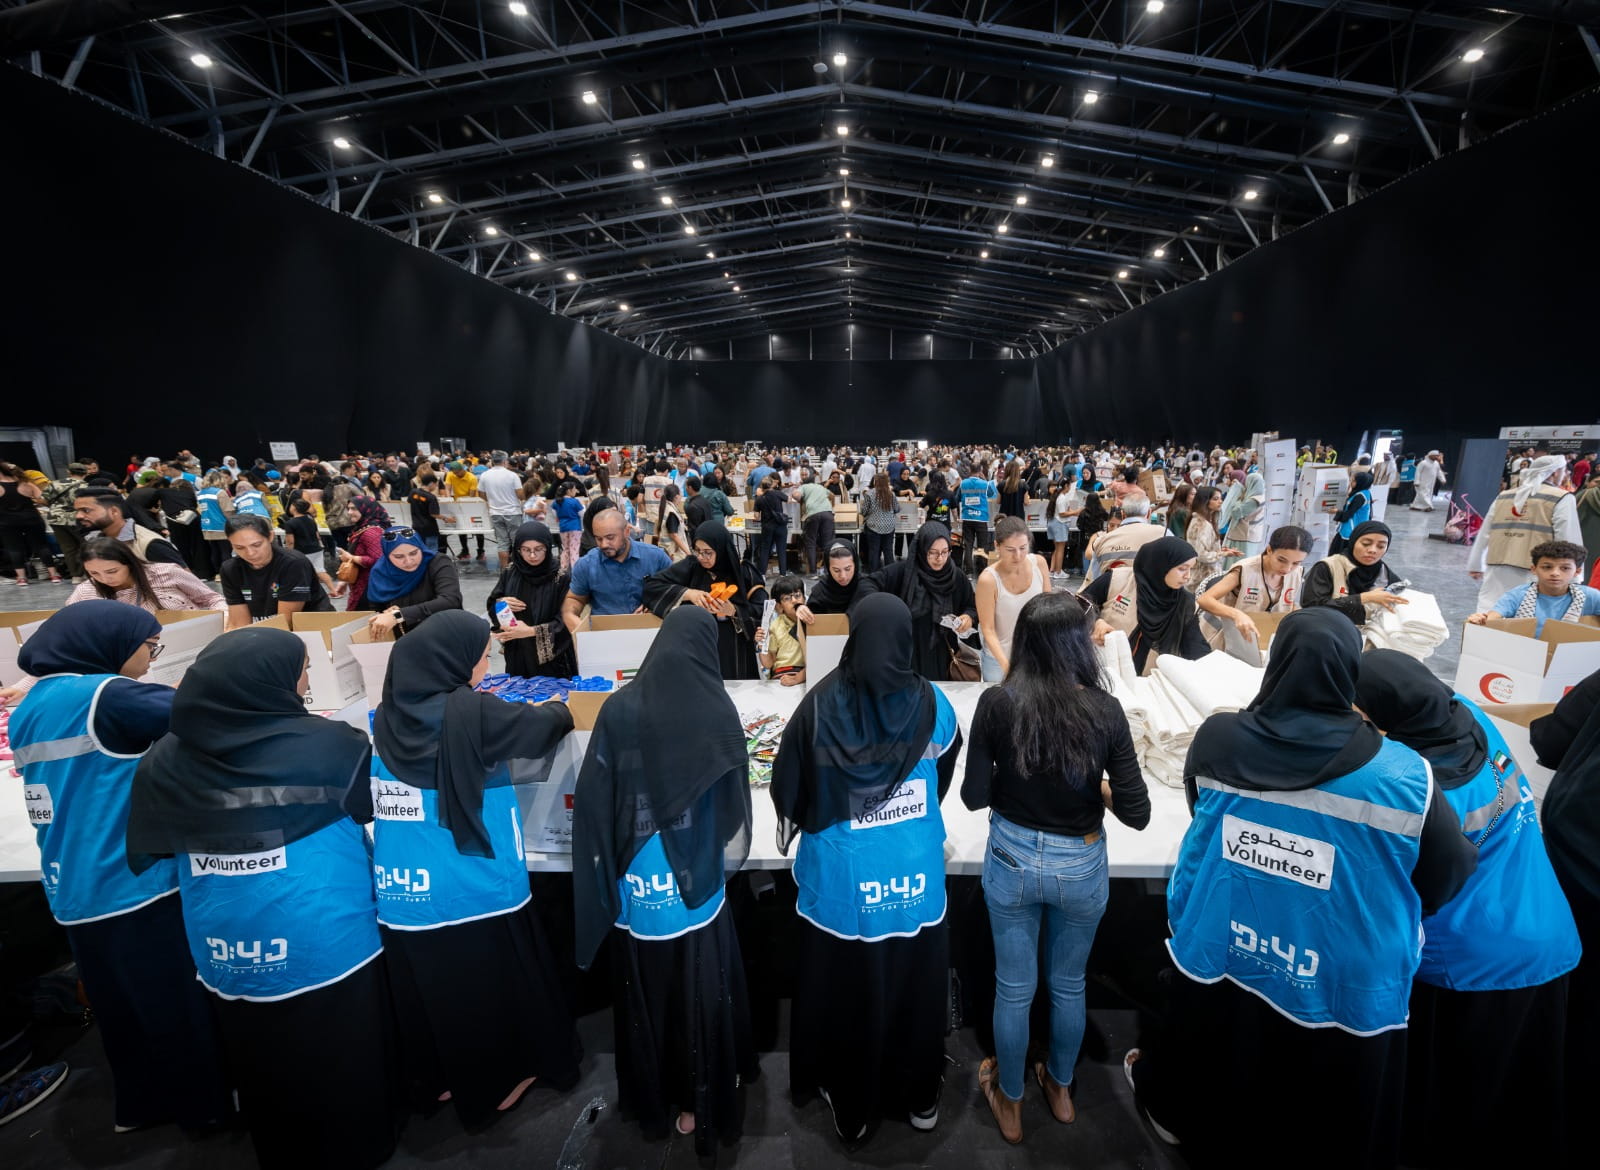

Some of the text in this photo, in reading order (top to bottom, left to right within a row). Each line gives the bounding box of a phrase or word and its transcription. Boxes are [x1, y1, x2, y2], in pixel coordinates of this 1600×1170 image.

[855, 802, 924, 825] Volunteer
[1238, 831, 1314, 858] متطوع
[195, 855, 281, 872] Volunteer
[1226, 840, 1326, 884] Volunteer
